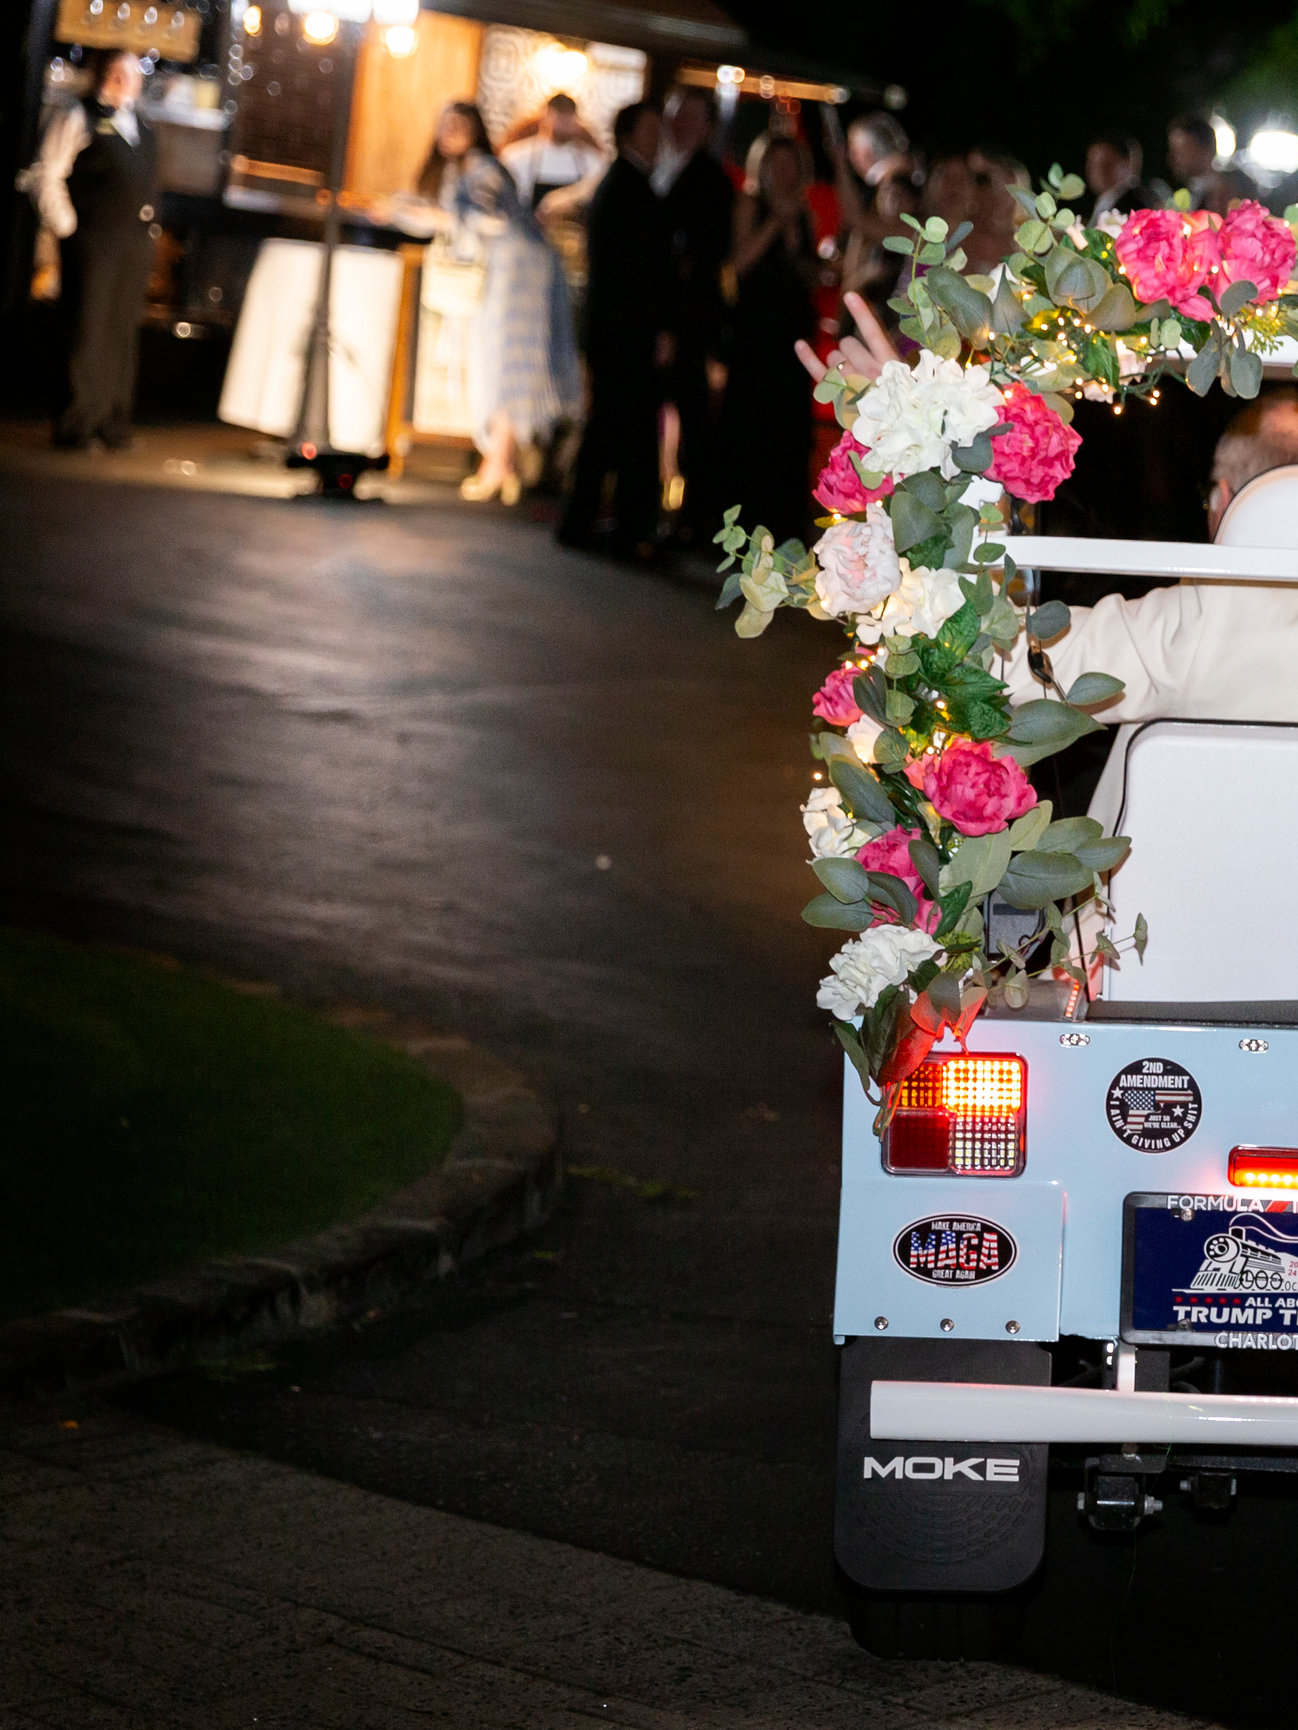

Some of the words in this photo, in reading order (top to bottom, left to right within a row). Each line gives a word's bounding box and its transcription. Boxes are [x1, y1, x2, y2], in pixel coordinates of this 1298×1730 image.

[1142, 1060, 1163, 1074] 2ND
[1119, 1074, 1190, 1089] AMENDMENT
[1110, 1109, 1132, 1138] AIN'T
[1131, 1135, 1171, 1149] GIVING
[1171, 1128, 1186, 1143] UP
[1183, 1102, 1198, 1129] SHIT
[1167, 1194, 1264, 1213] FORMULA
[931, 1221, 951, 1231] MAKE
[952, 1222, 981, 1232] AMERICA
[909, 1230, 999, 1270] MAGA
[1289, 1260, 1298, 1268] 20
[932, 1269, 953, 1279] GREAT
[955, 1270, 976, 1279] AGAIN
[1287, 1269, 1297, 1277] 24
[1245, 1296, 1272, 1307] ALL
[1173, 1305, 1273, 1325] TRUMP
[863, 1456, 1020, 1482] MOKE
